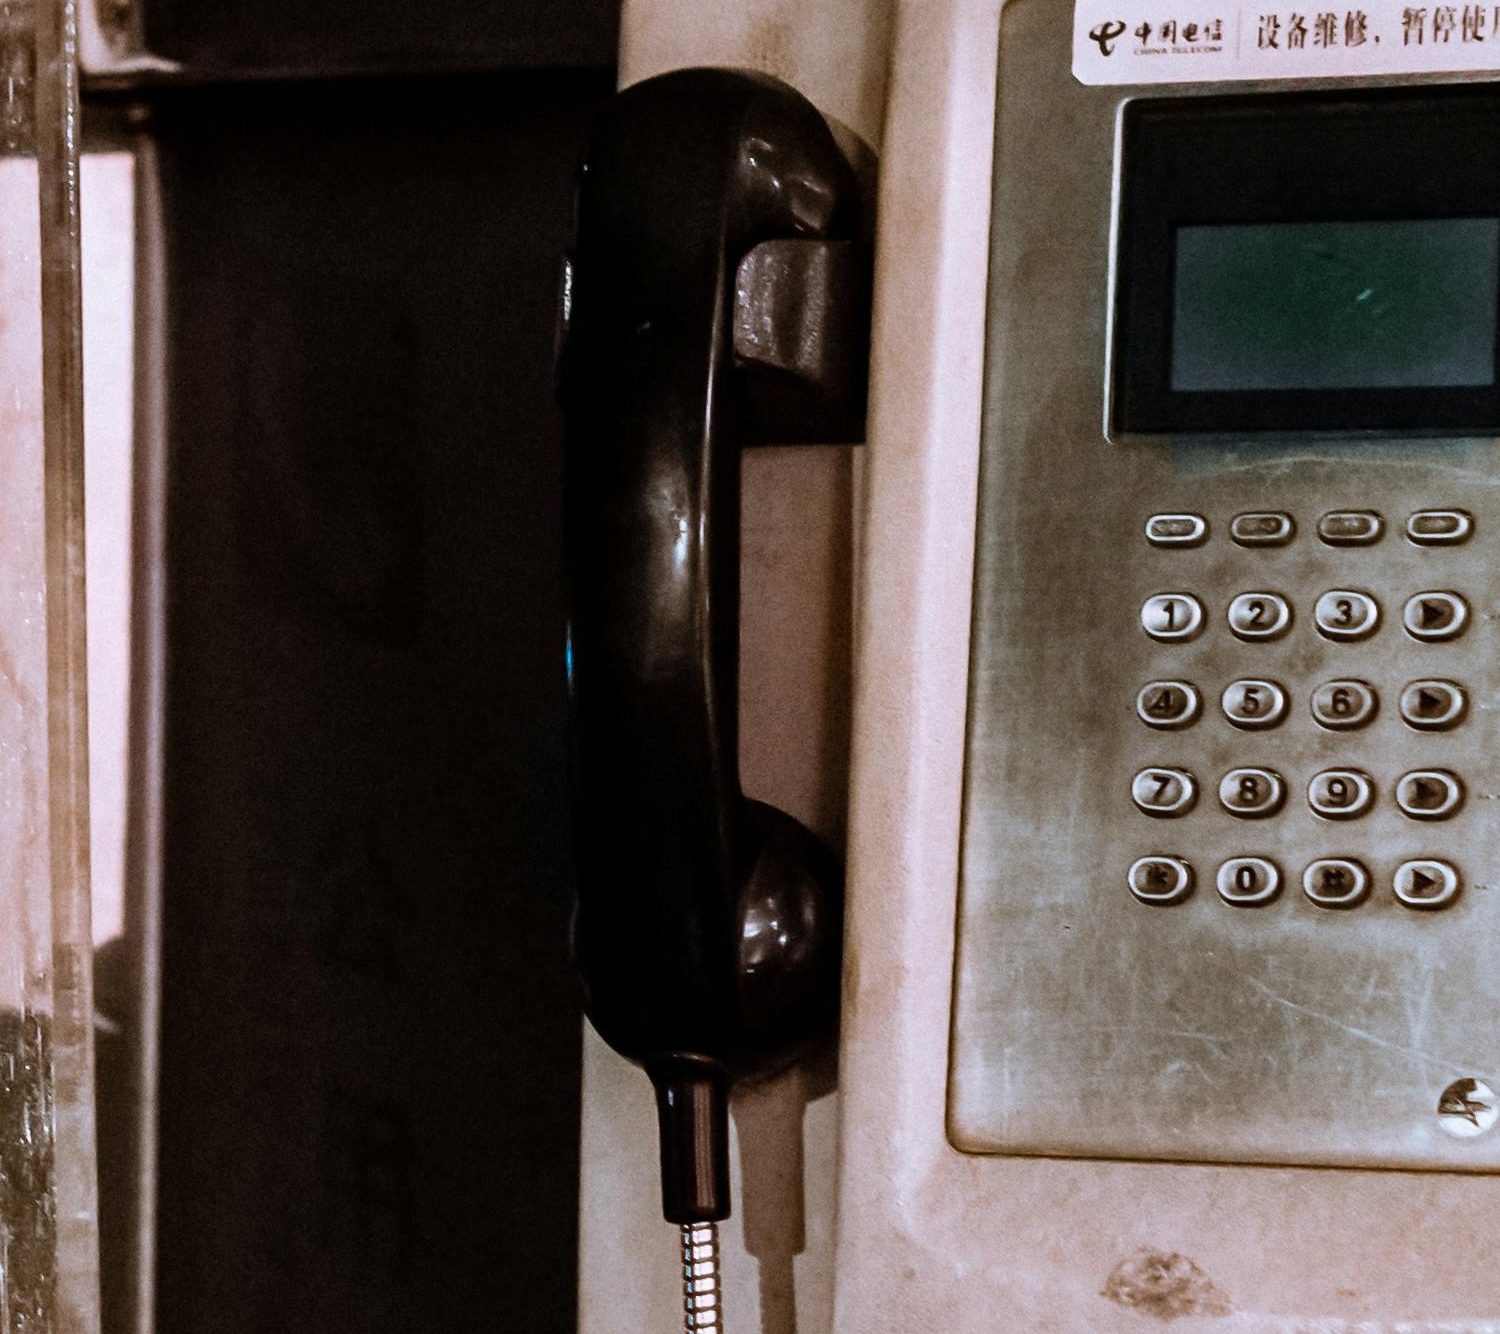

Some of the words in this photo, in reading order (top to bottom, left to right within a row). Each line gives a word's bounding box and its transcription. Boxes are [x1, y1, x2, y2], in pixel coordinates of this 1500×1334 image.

[1134, 19, 1223, 45] 中国电信
[1162, 601, 1176, 629] 1
[1248, 600, 1267, 624] 2
[1335, 599, 1352, 625] 3
[1151, 689, 1171, 712] 4
[1243, 688, 1260, 715] 5
[1330, 688, 1352, 716] 6
[1152, 774, 1172, 803] 7
[1238, 777, 1259, 802] 8
[1327, 778, 1348, 805] 9
[1234, 866, 1257, 890] 0
